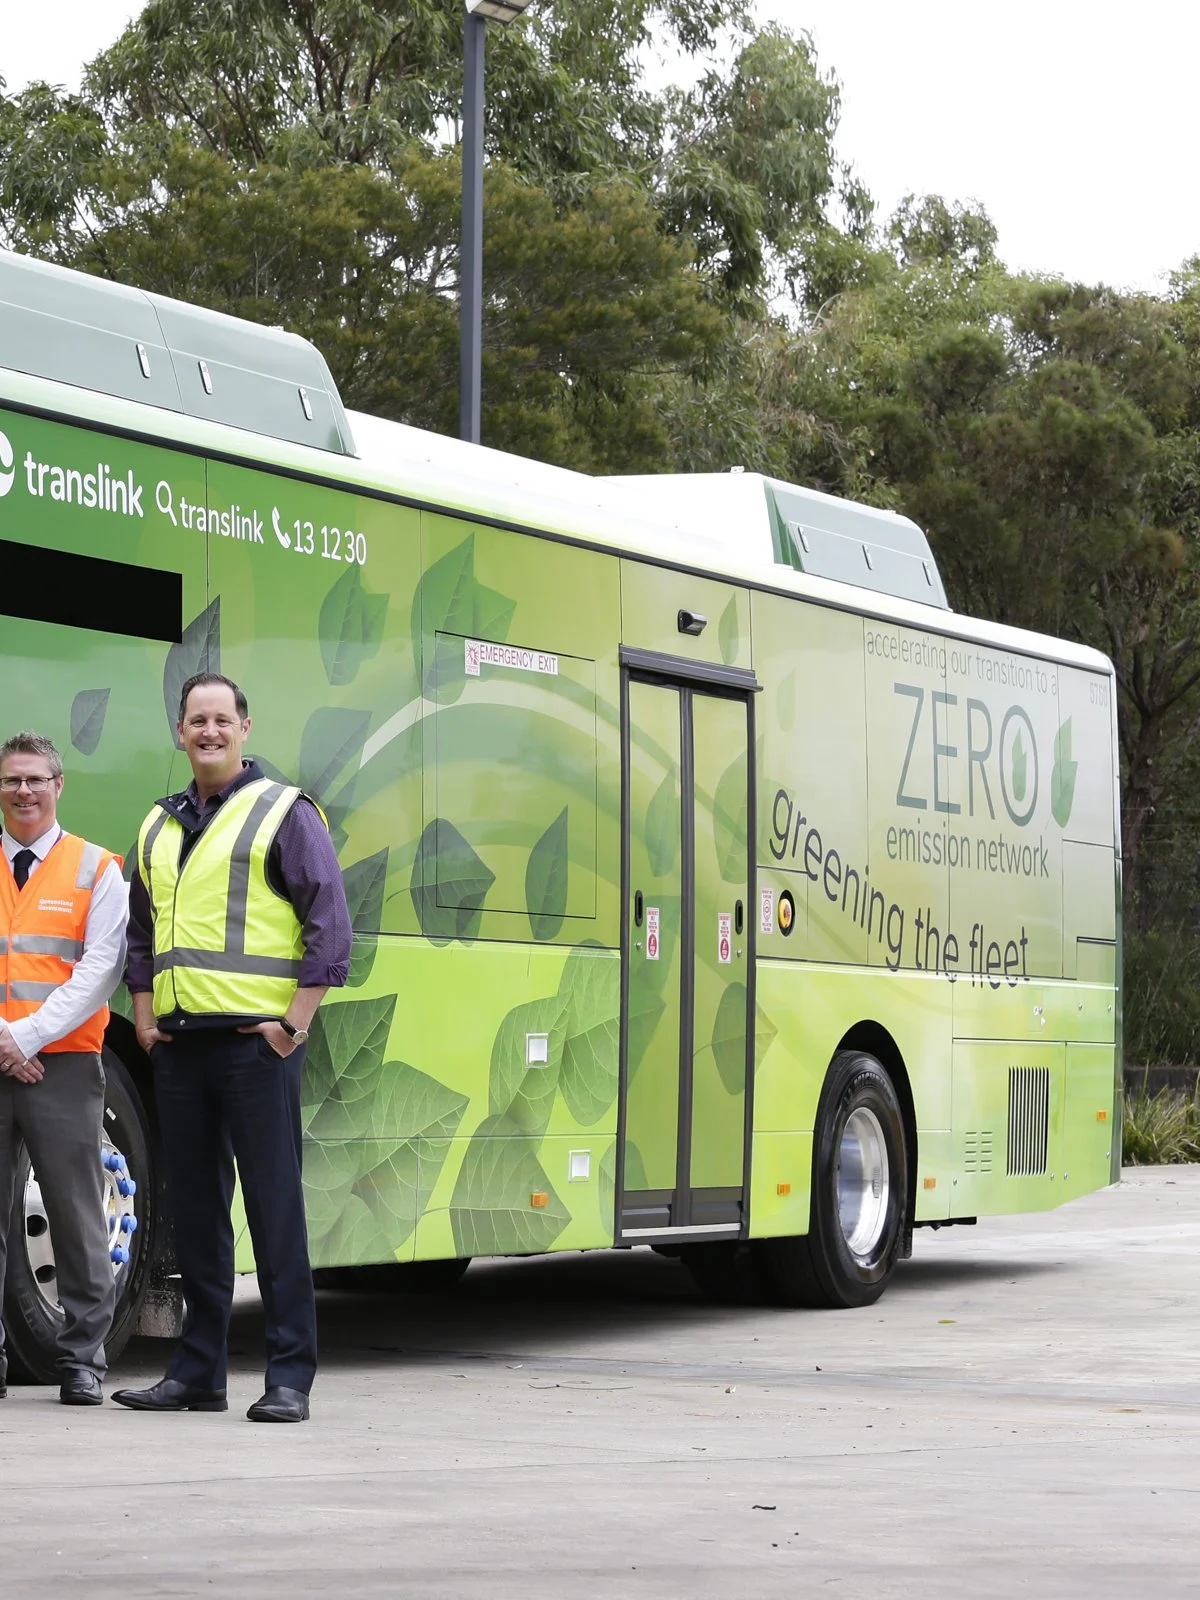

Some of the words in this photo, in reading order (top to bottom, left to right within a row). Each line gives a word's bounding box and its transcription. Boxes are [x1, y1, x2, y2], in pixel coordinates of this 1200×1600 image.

[24, 451, 145, 518] translink
[179, 496, 265, 545] translink
[293, 519, 315, 555] 13
[480, 644, 534, 668] EMERGENCY
[538, 655, 557, 673] EXIT
[866, 631, 947, 679] accelerating
[951, 649, 972, 676] our
[976, 653, 1033, 690] transition
[1035, 668, 1048, 695] to
[1050, 673, 1058, 696] a
[1090, 682, 1109, 707] 5760
[894, 682, 1039, 828] ZERO
[886, 817, 971, 869] emission
[976, 834, 1050, 879] network
[769, 788, 905, 972] greening
[914, 907, 960, 984] the
[969, 923, 1031, 990] fleet
